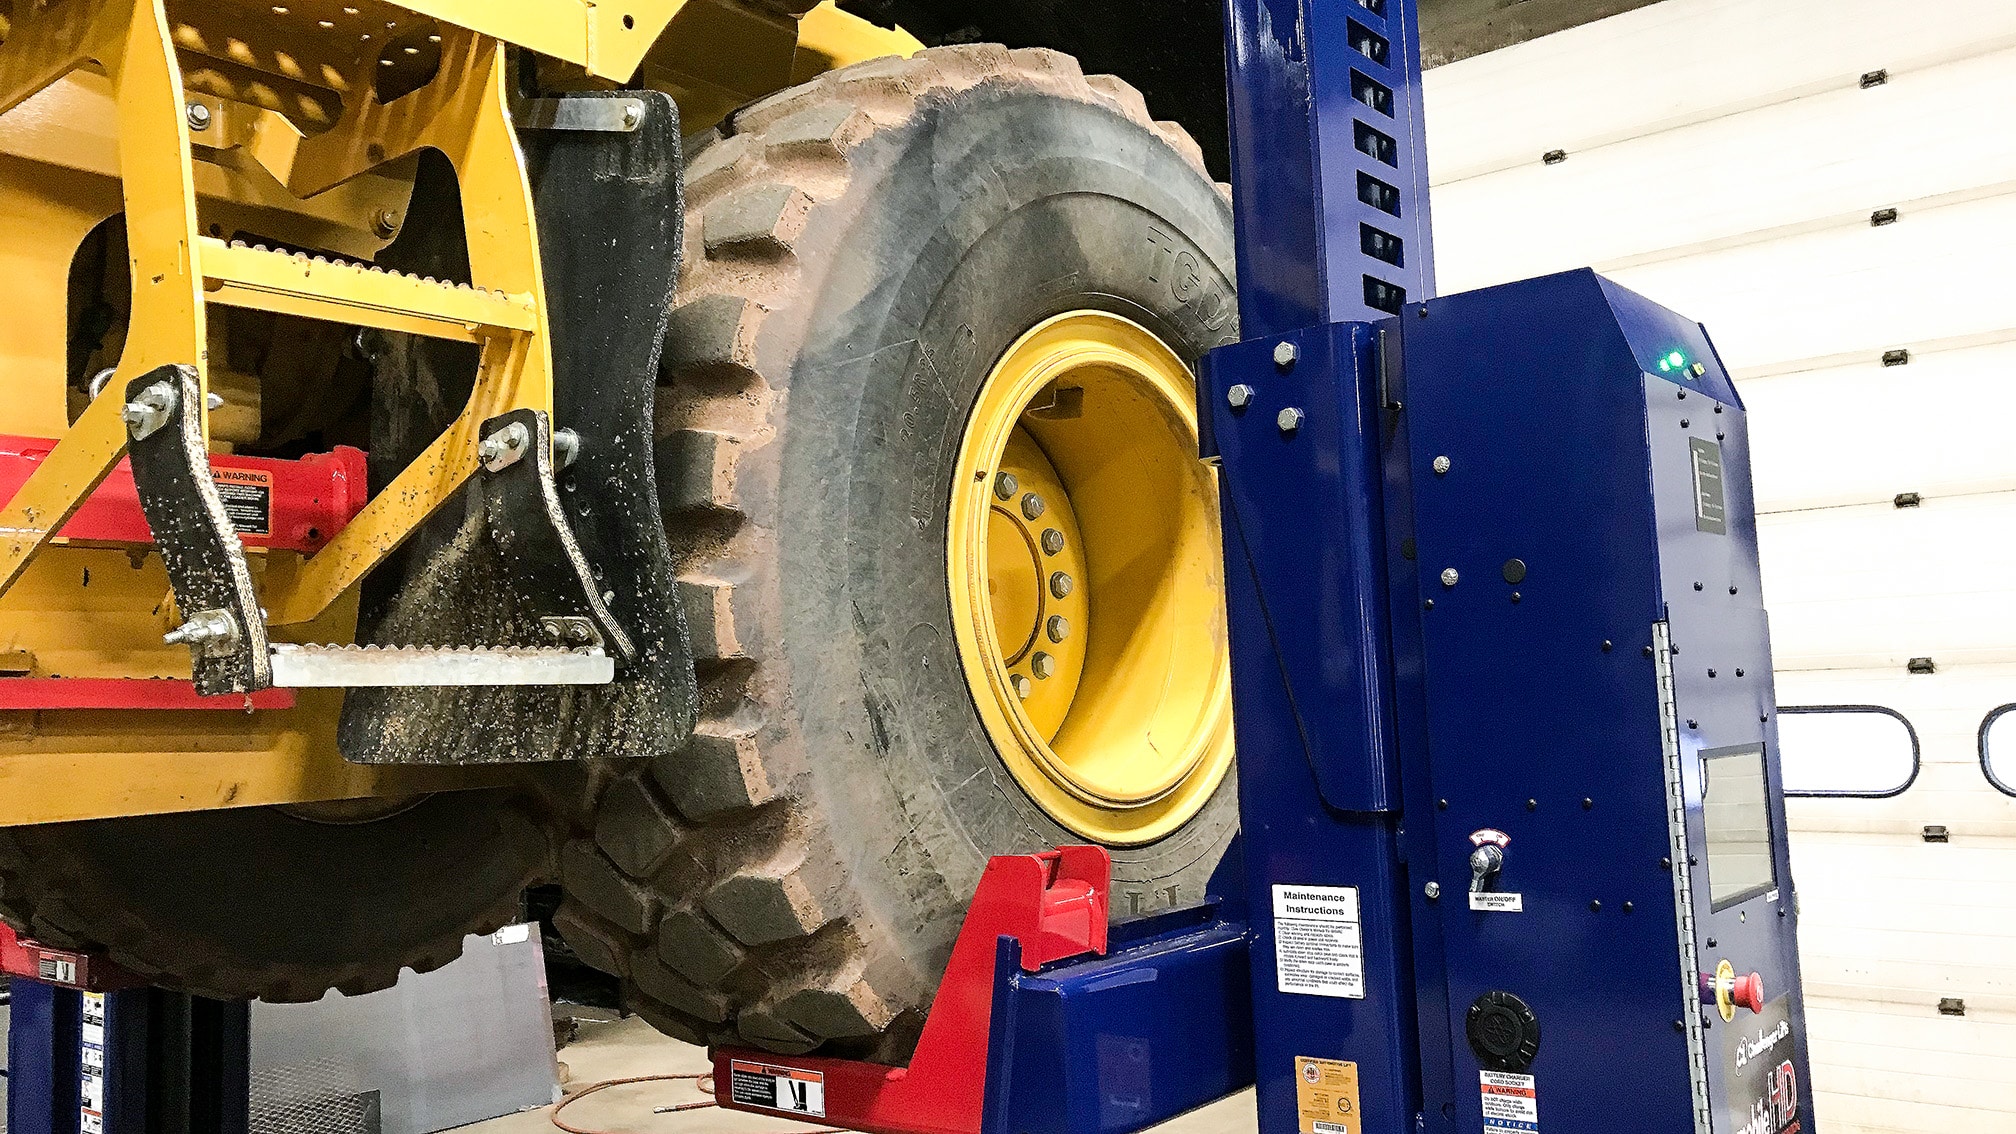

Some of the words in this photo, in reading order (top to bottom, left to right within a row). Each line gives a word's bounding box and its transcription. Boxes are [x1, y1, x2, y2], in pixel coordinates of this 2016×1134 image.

[222, 472, 268, 483] WARNING
[1283, 891, 1345, 902] Maintenance
[1286, 904, 1345, 916] Instructions
[1496, 1087, 1527, 1096] WARNING
[1489, 1119, 1532, 1130] NOTICE
